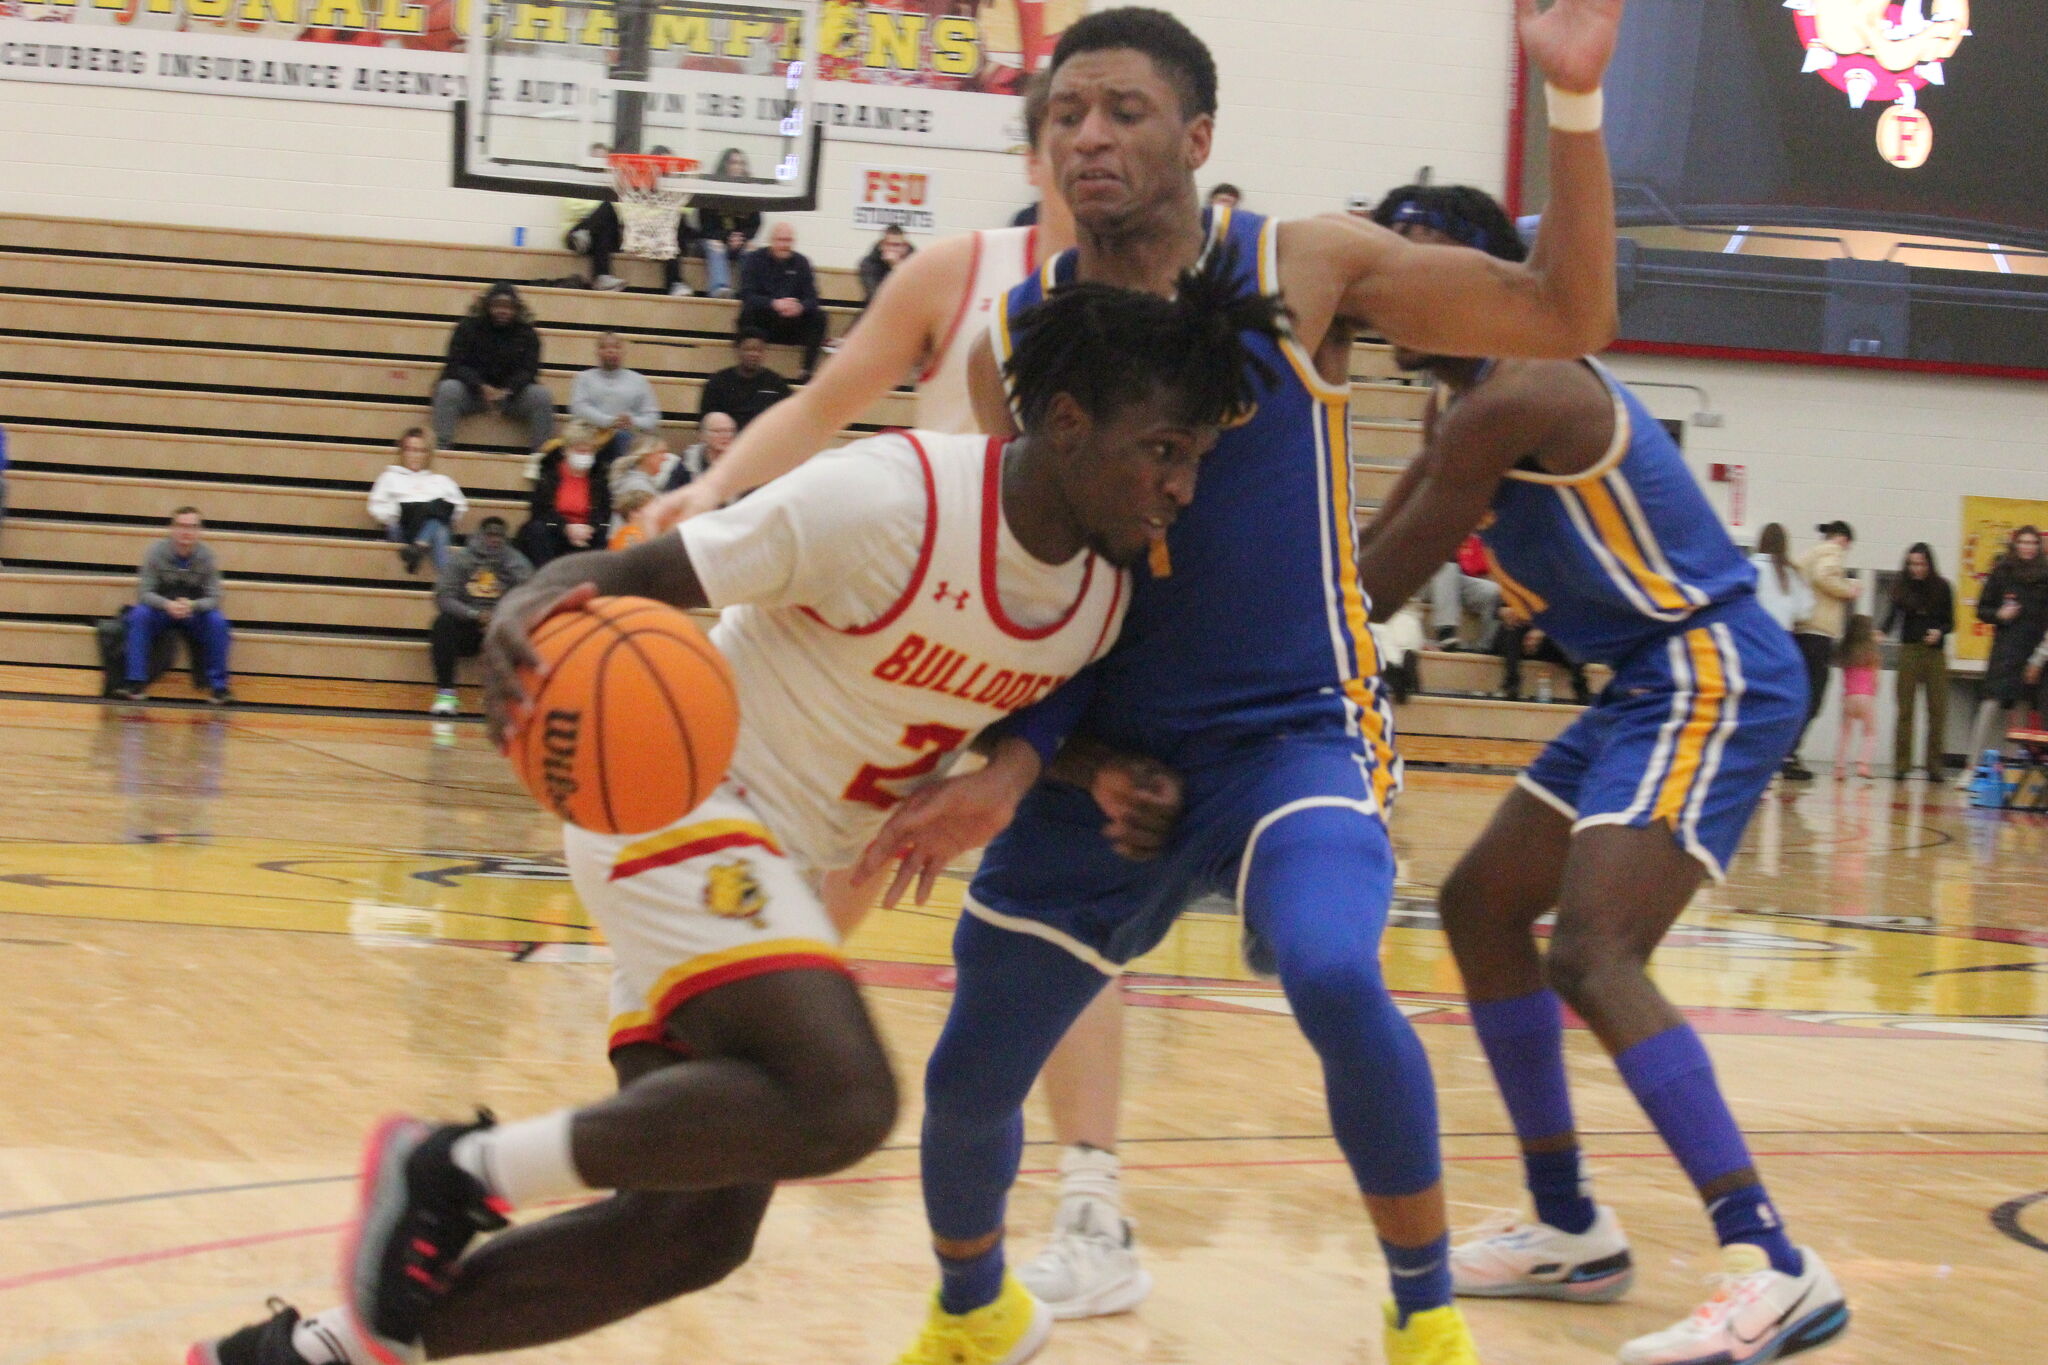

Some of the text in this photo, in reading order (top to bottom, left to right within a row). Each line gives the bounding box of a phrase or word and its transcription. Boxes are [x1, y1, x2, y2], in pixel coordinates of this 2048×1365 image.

[158, 52, 341, 88] INSURANCE
[757, 97, 934, 134] INURANCE
[863, 170, 927, 206] FSU
[871, 632, 1068, 713] BULLDO
[842, 721, 970, 812] 2
